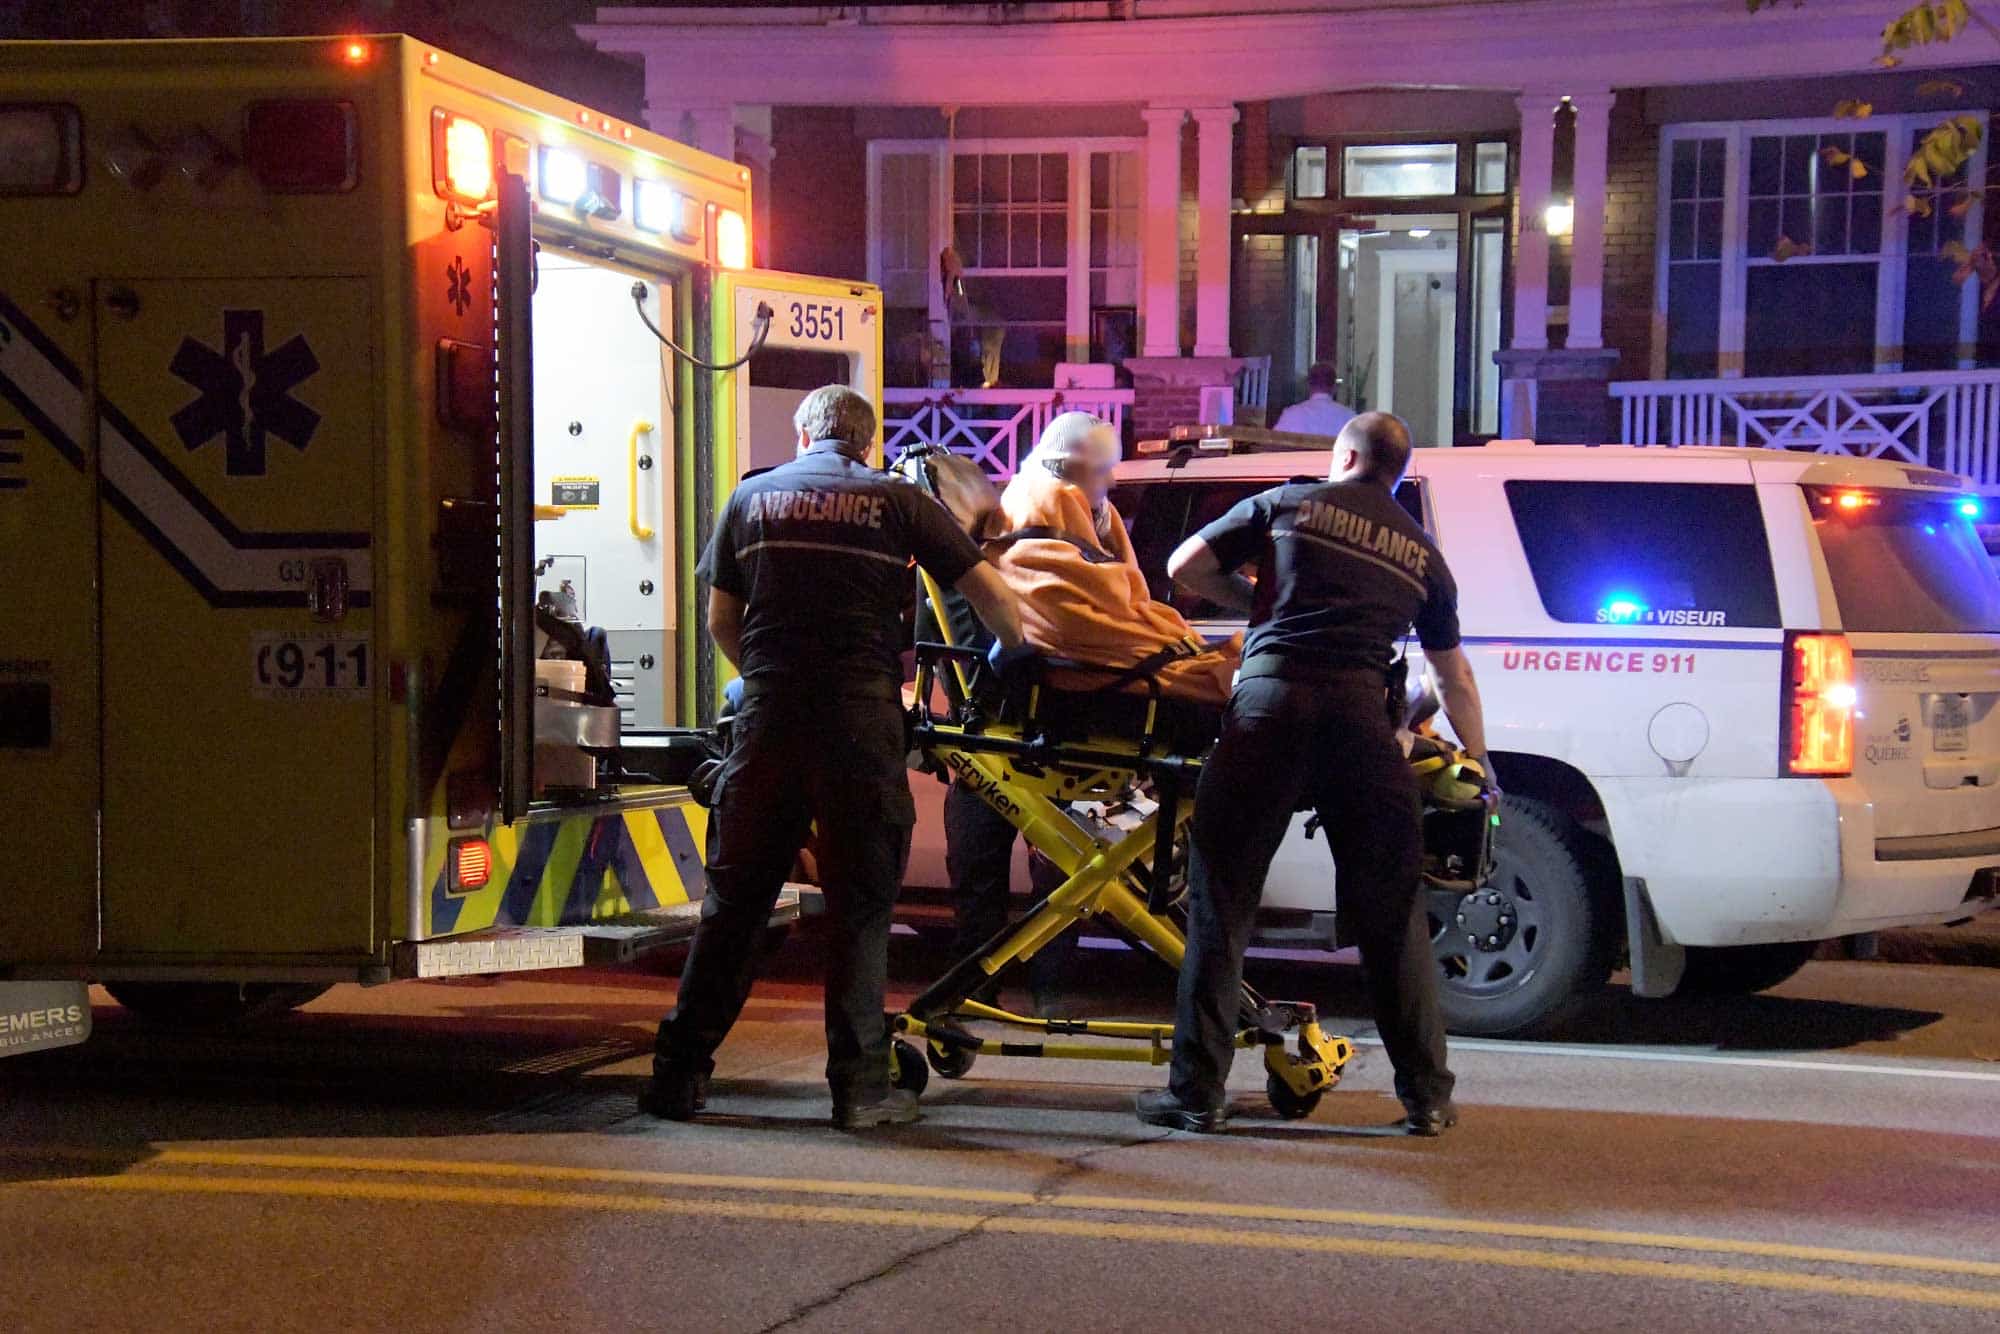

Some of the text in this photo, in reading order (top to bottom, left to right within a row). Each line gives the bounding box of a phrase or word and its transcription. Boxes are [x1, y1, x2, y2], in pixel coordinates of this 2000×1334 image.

[790, 302, 843, 341] 3551
[746, 490, 884, 529] AMBULANCE
[1294, 499, 1429, 577] AMBULANCE
[1503, 651, 1695, 673] URGENCE 911
[948, 751, 1020, 817] stryker
